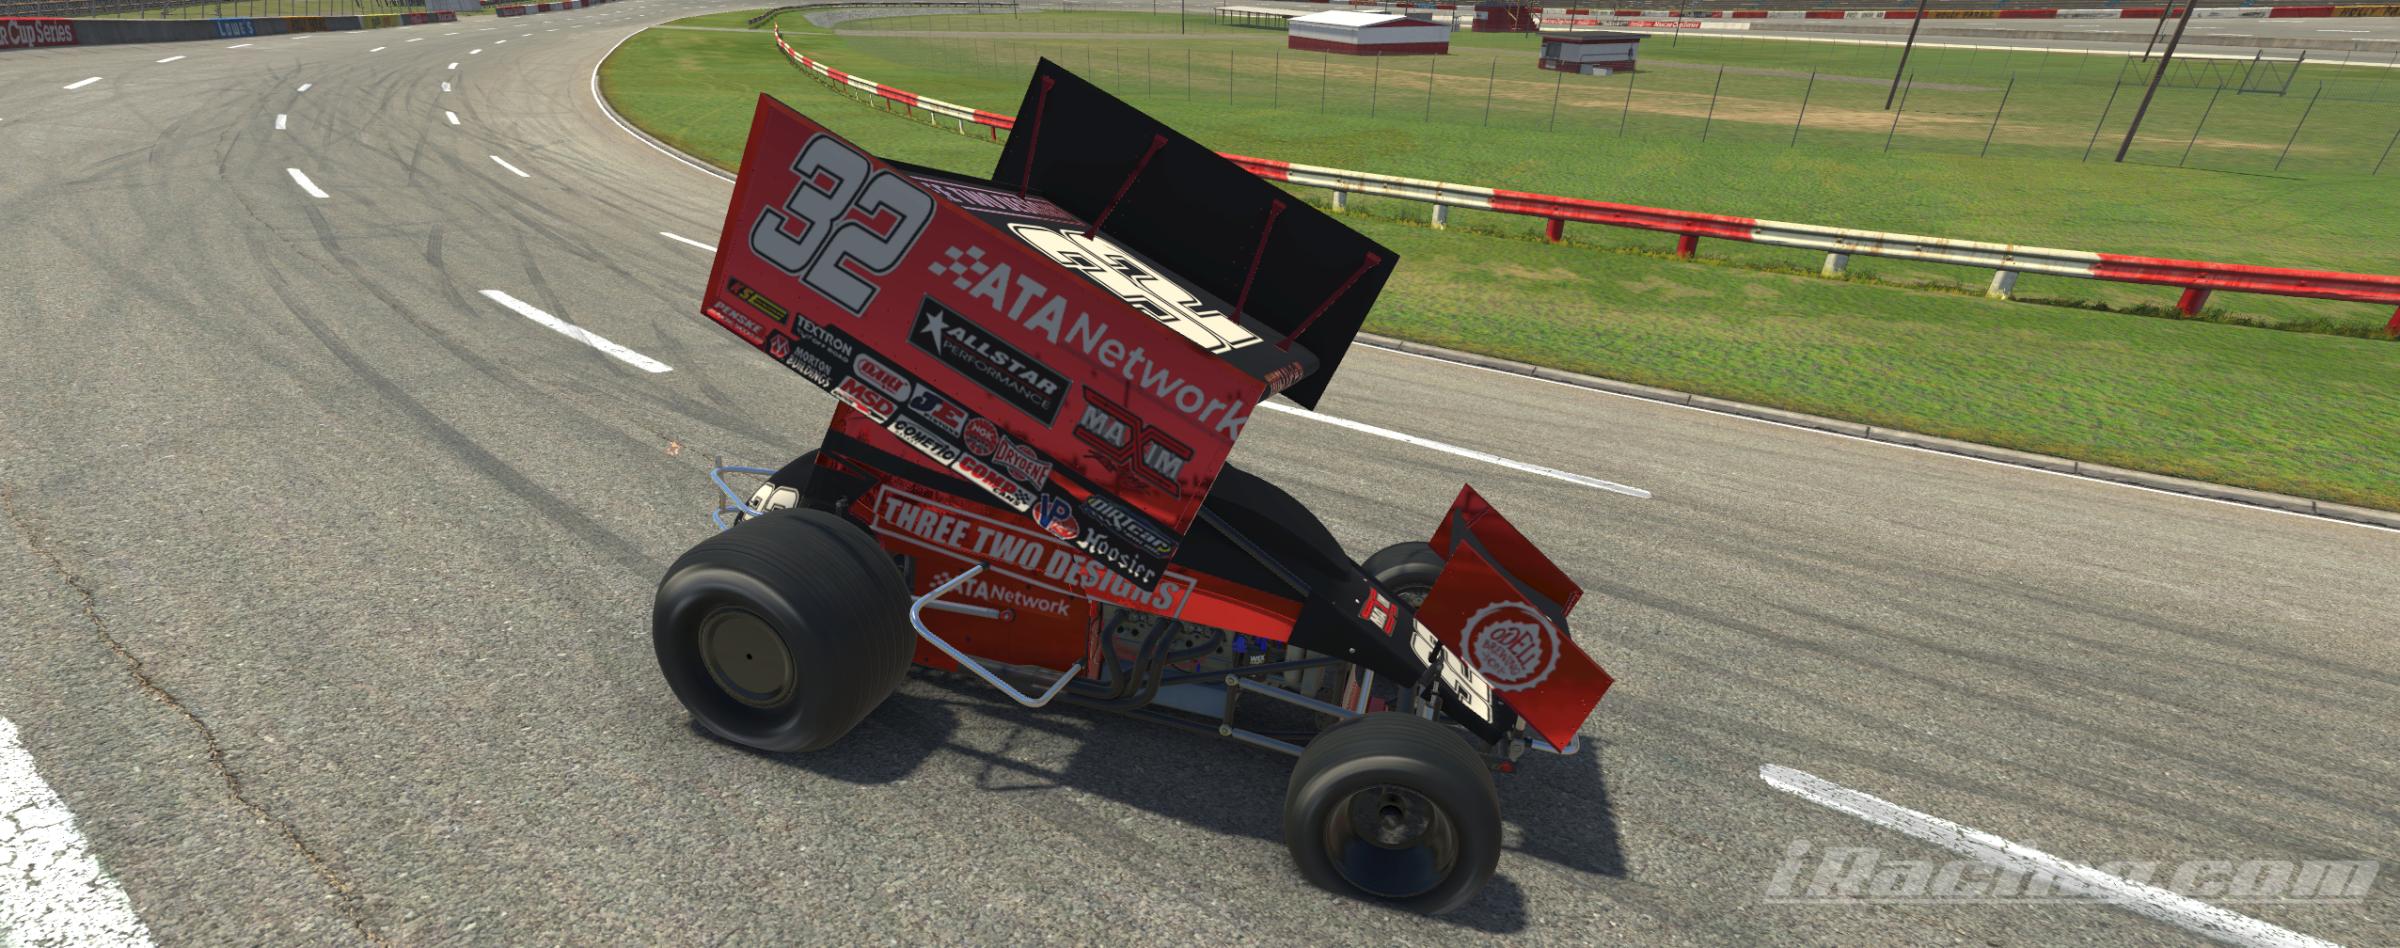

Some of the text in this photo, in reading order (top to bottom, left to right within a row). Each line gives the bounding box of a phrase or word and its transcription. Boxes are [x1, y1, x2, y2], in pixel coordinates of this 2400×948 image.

[8, 20, 36, 47] Cup
[36, 20, 72, 43] Series
[748, 131, 937, 318] 32
[798, 315, 853, 357] TEXTRON
[786, 355, 831, 388] BUILDINGS
[794, 346, 832, 374] MORTON
[943, 340, 1051, 410] PERFORMANCE
[946, 327, 1058, 395] ALLSTAR
[841, 378, 894, 417] MSD
[910, 391, 965, 429] JE
[1076, 392, 1194, 492] MAXIM
[959, 456, 1017, 494] COMP
[1039, 494, 1072, 529] VP
[884, 497, 971, 549] THREE
[972, 526, 1043, 571] TWO
[1077, 527, 1155, 584] Hoosier
[1490, 627, 1536, 670] ODELL
